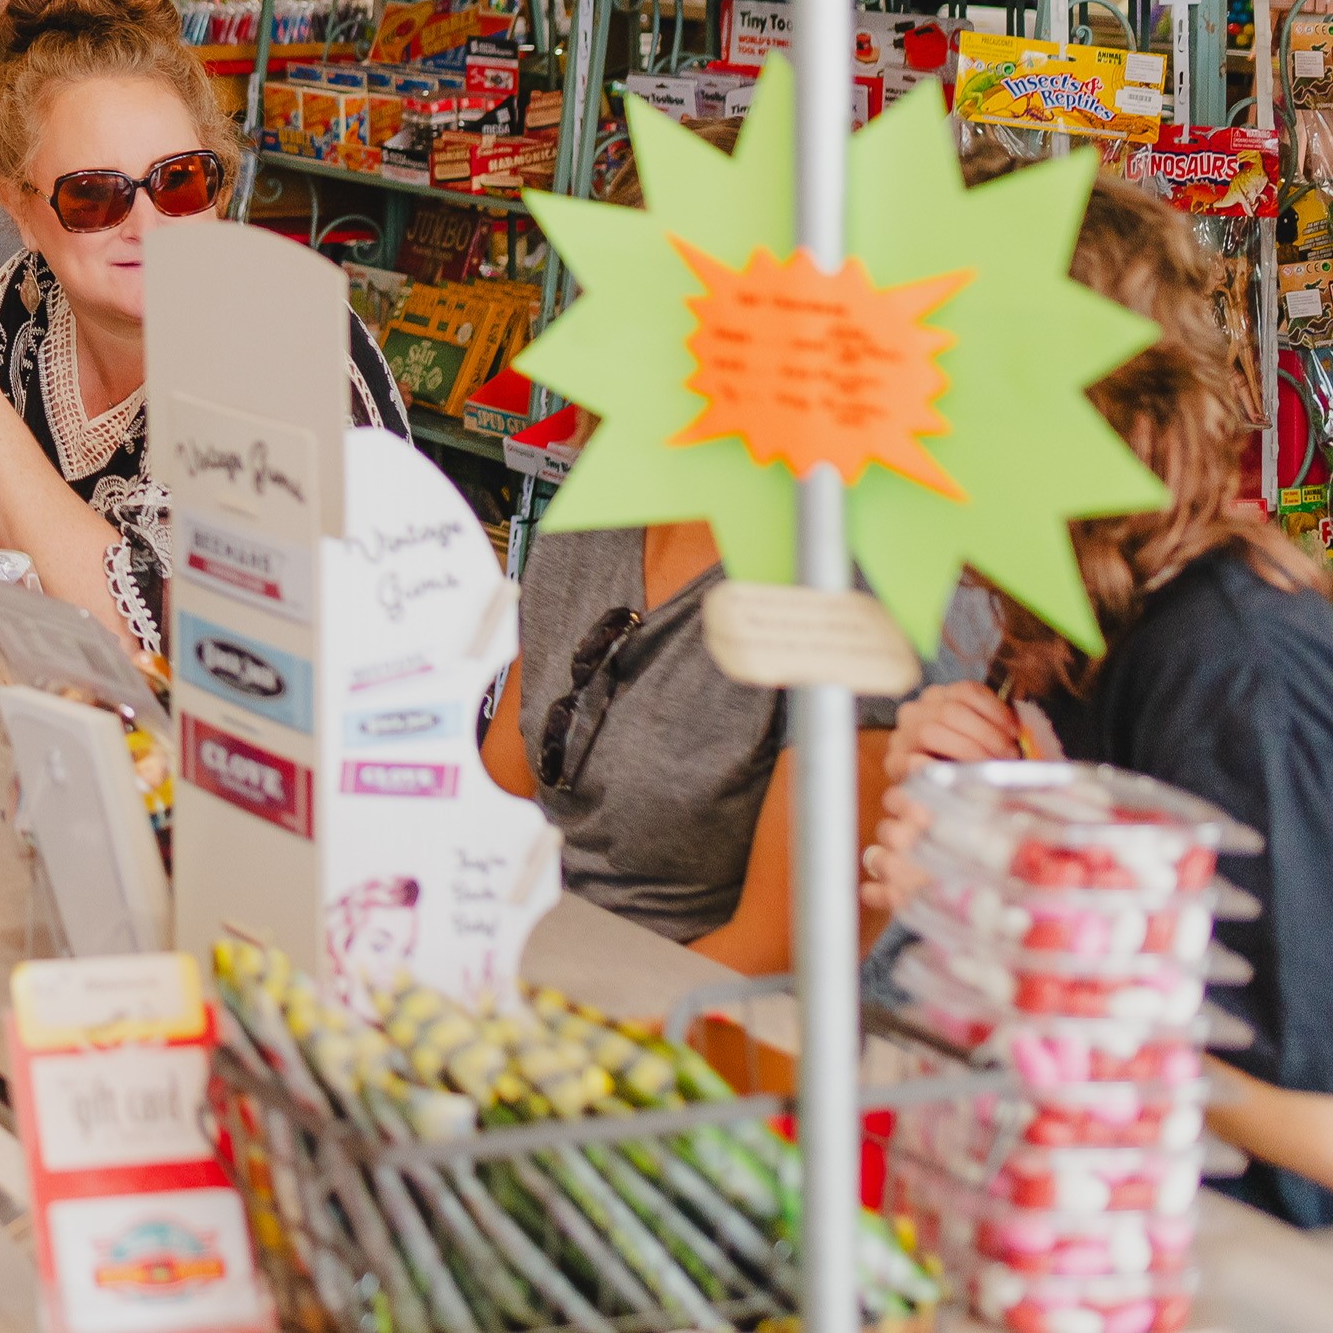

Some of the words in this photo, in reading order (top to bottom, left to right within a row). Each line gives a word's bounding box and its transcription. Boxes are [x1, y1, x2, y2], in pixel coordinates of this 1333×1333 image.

[739, 10, 768, 33] Tiny
[1097, 50, 1123, 61] ANIMAL
[1004, 74, 1080, 100] Insects
[650, 93, 685, 106] Toolbox
[1040, 89, 1116, 122] Reptiles
[1126, 151, 1241, 182] DNOSAURS
[405, 210, 473, 252] JUMBO
[476, 409, 505, 428] SPUD
